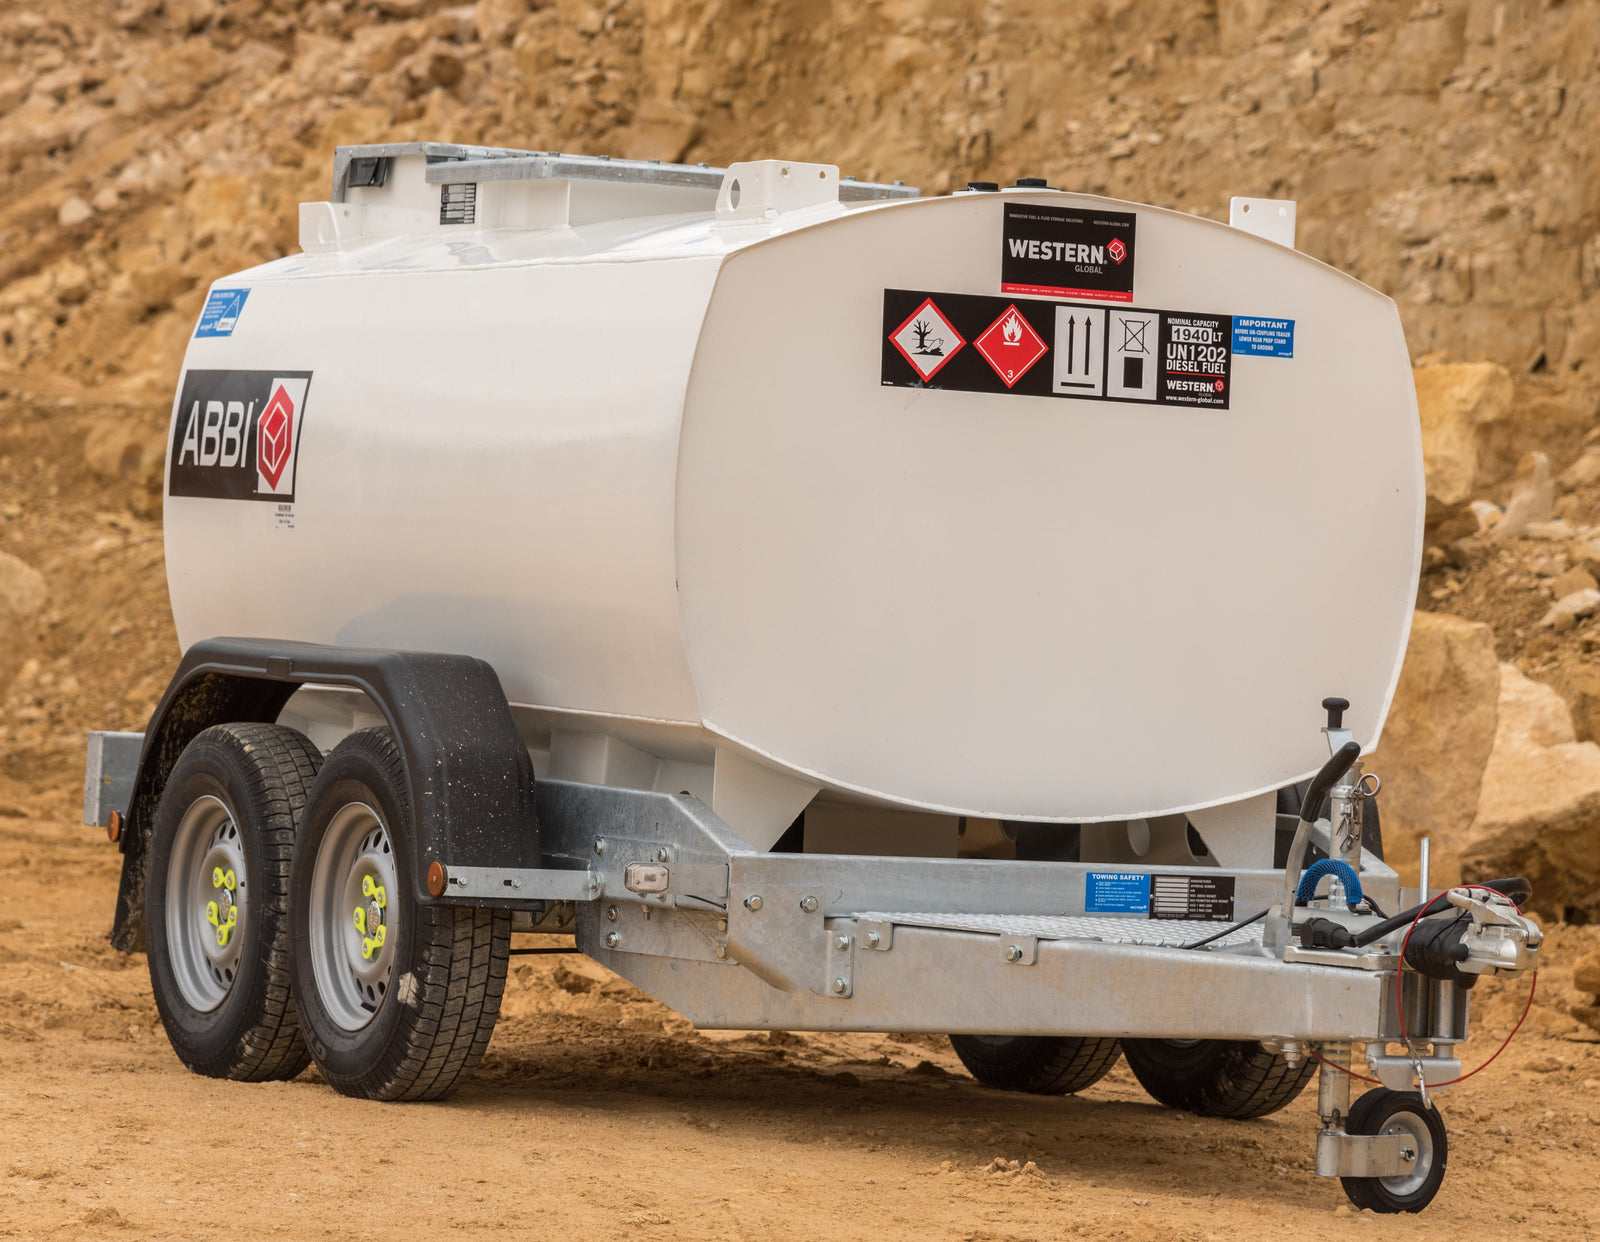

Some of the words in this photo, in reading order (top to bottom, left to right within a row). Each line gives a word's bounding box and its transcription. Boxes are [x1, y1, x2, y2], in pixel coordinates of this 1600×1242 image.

[1008, 238, 1104, 265] WESTERN
[1074, 264, 1103, 274] GLOBAL
[1167, 317, 1192, 326] NOMINAL
[1192, 319, 1219, 328] CAPACITY
[1239, 319, 1288, 329] IMPORTANT
[1173, 328, 1210, 342] 1940
[1213, 332, 1223, 343] LT
[1166, 343, 1227, 363] UN1202
[1166, 360, 1200, 373] DIESEL
[1202, 362, 1226, 374] FUEL
[1007, 369, 1014, 379] 3
[1165, 394, 1224, 404] www.western-global.com
[178, 400, 254, 468] ABBI
